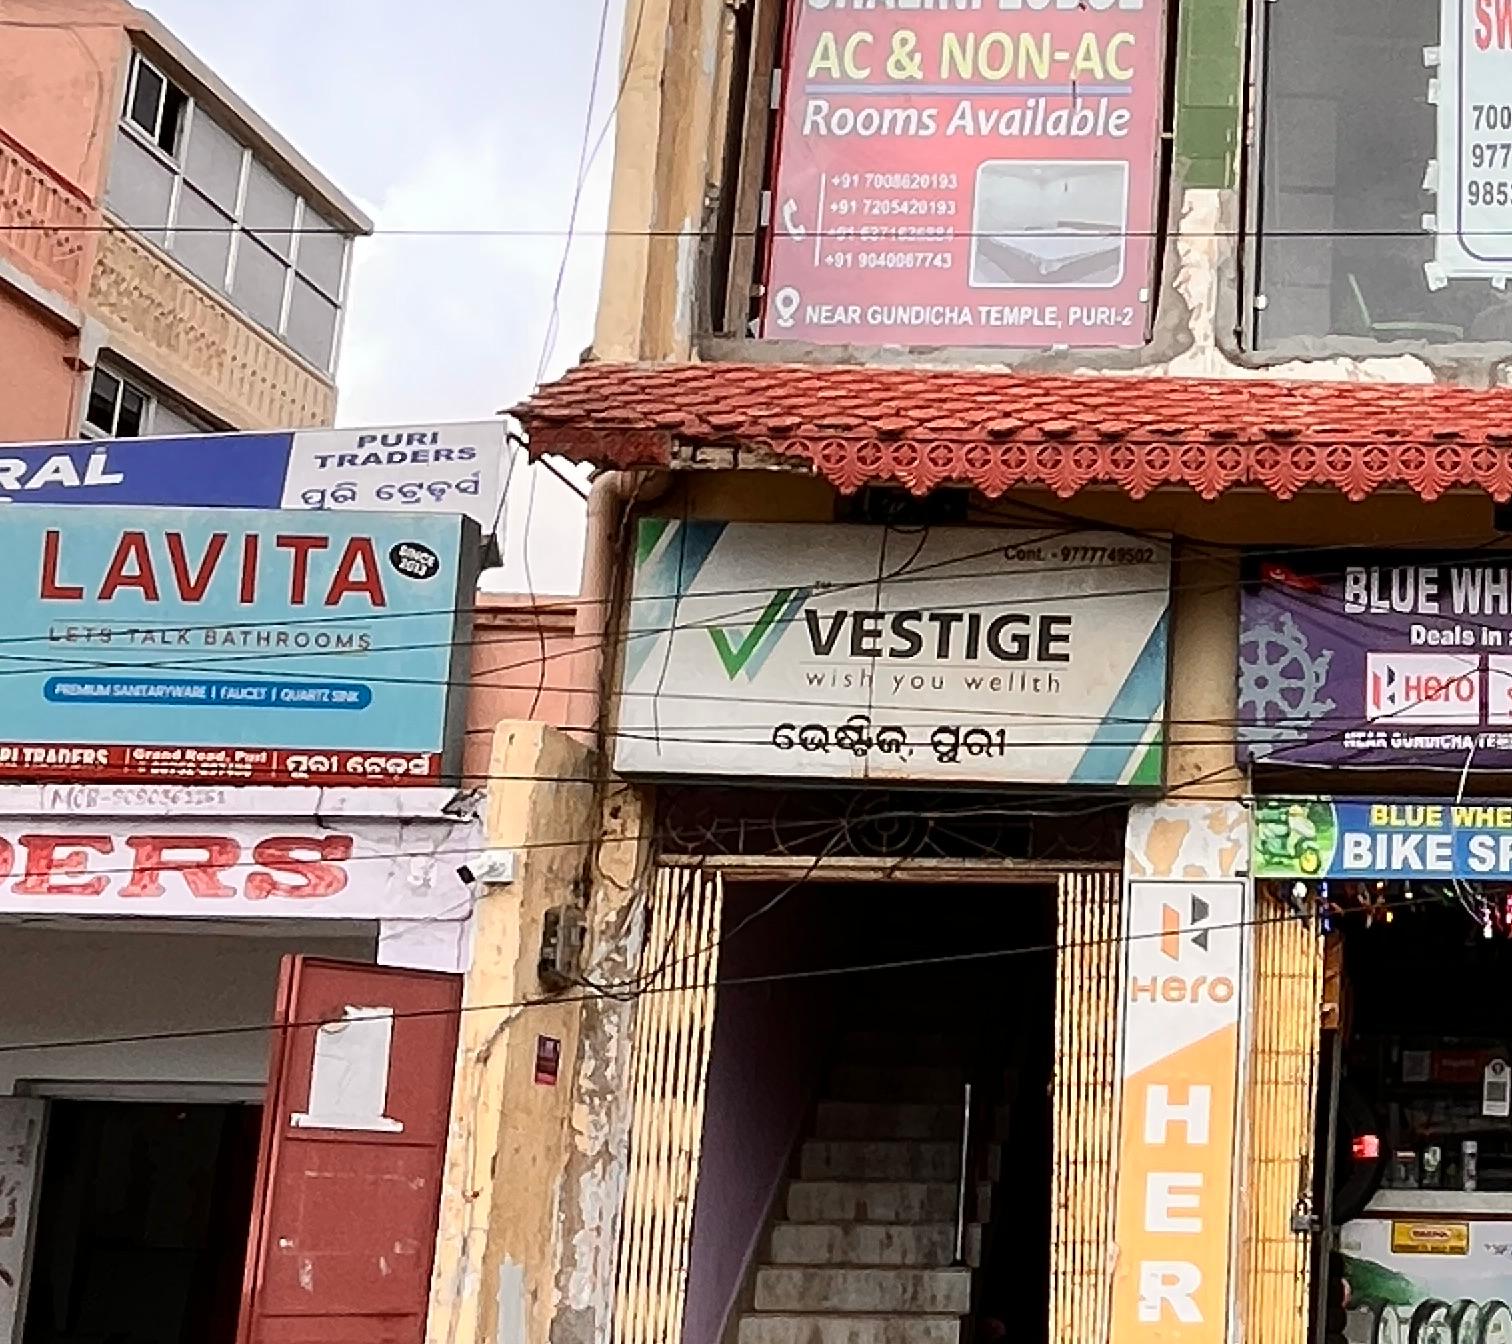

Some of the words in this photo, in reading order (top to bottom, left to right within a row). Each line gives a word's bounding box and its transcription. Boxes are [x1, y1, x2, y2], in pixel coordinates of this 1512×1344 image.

[807, 31, 874, 80] AC
[886, 30, 924, 80] &
[940, 32, 1136, 81] NON-AC
[802, 100, 937, 137] Rooms
[946, 97, 1131, 137] Available
[831, 174, 859, 188] +91
[830, 200, 857, 214] +91
[825, 253, 852, 267] +91
[805, 307, 861, 325] NEAR
[866, 307, 974, 326] GUNDICHA
[979, 307, 1062, 328] TEMPLE,
[1068, 307, 1133, 326] PURI-2
[357, 432, 439, 448] PURI
[314, 447, 476, 469] TRADERS
[1005, 545, 1045, 561] Cont.
[40, 530, 388, 607] LAVITA
[1345, 567, 1439, 613] BLUE
[49, 626, 113, 643] LETS
[129, 628, 191, 645] TALK
[204, 630, 371, 649] BATHROOMS
[805, 608, 1072, 663] VESTIGE
[1411, 625, 1475, 647] Deals
[1481, 626, 1502, 646] in
[54, 682, 112, 696] PREMIUM
[113, 683, 207, 699] SANITARYWARE
[220, 686, 267, 699] FAUCET
[280, 688, 329, 702] QUARTZ
[329, 690, 359, 702] SINK
[806, 669, 873, 688] wish
[893, 672, 945, 696] you
[964, 669, 1062, 694] wellth
[1404, 675, 1475, 702] Hero
[1344, 732, 1388, 748] NEAR
[133, 748, 181, 761] Grand
[1371, 806, 1446, 827] BLUE
[1343, 833, 1454, 870] BIKE
[0, 835, 354, 900] ERS
